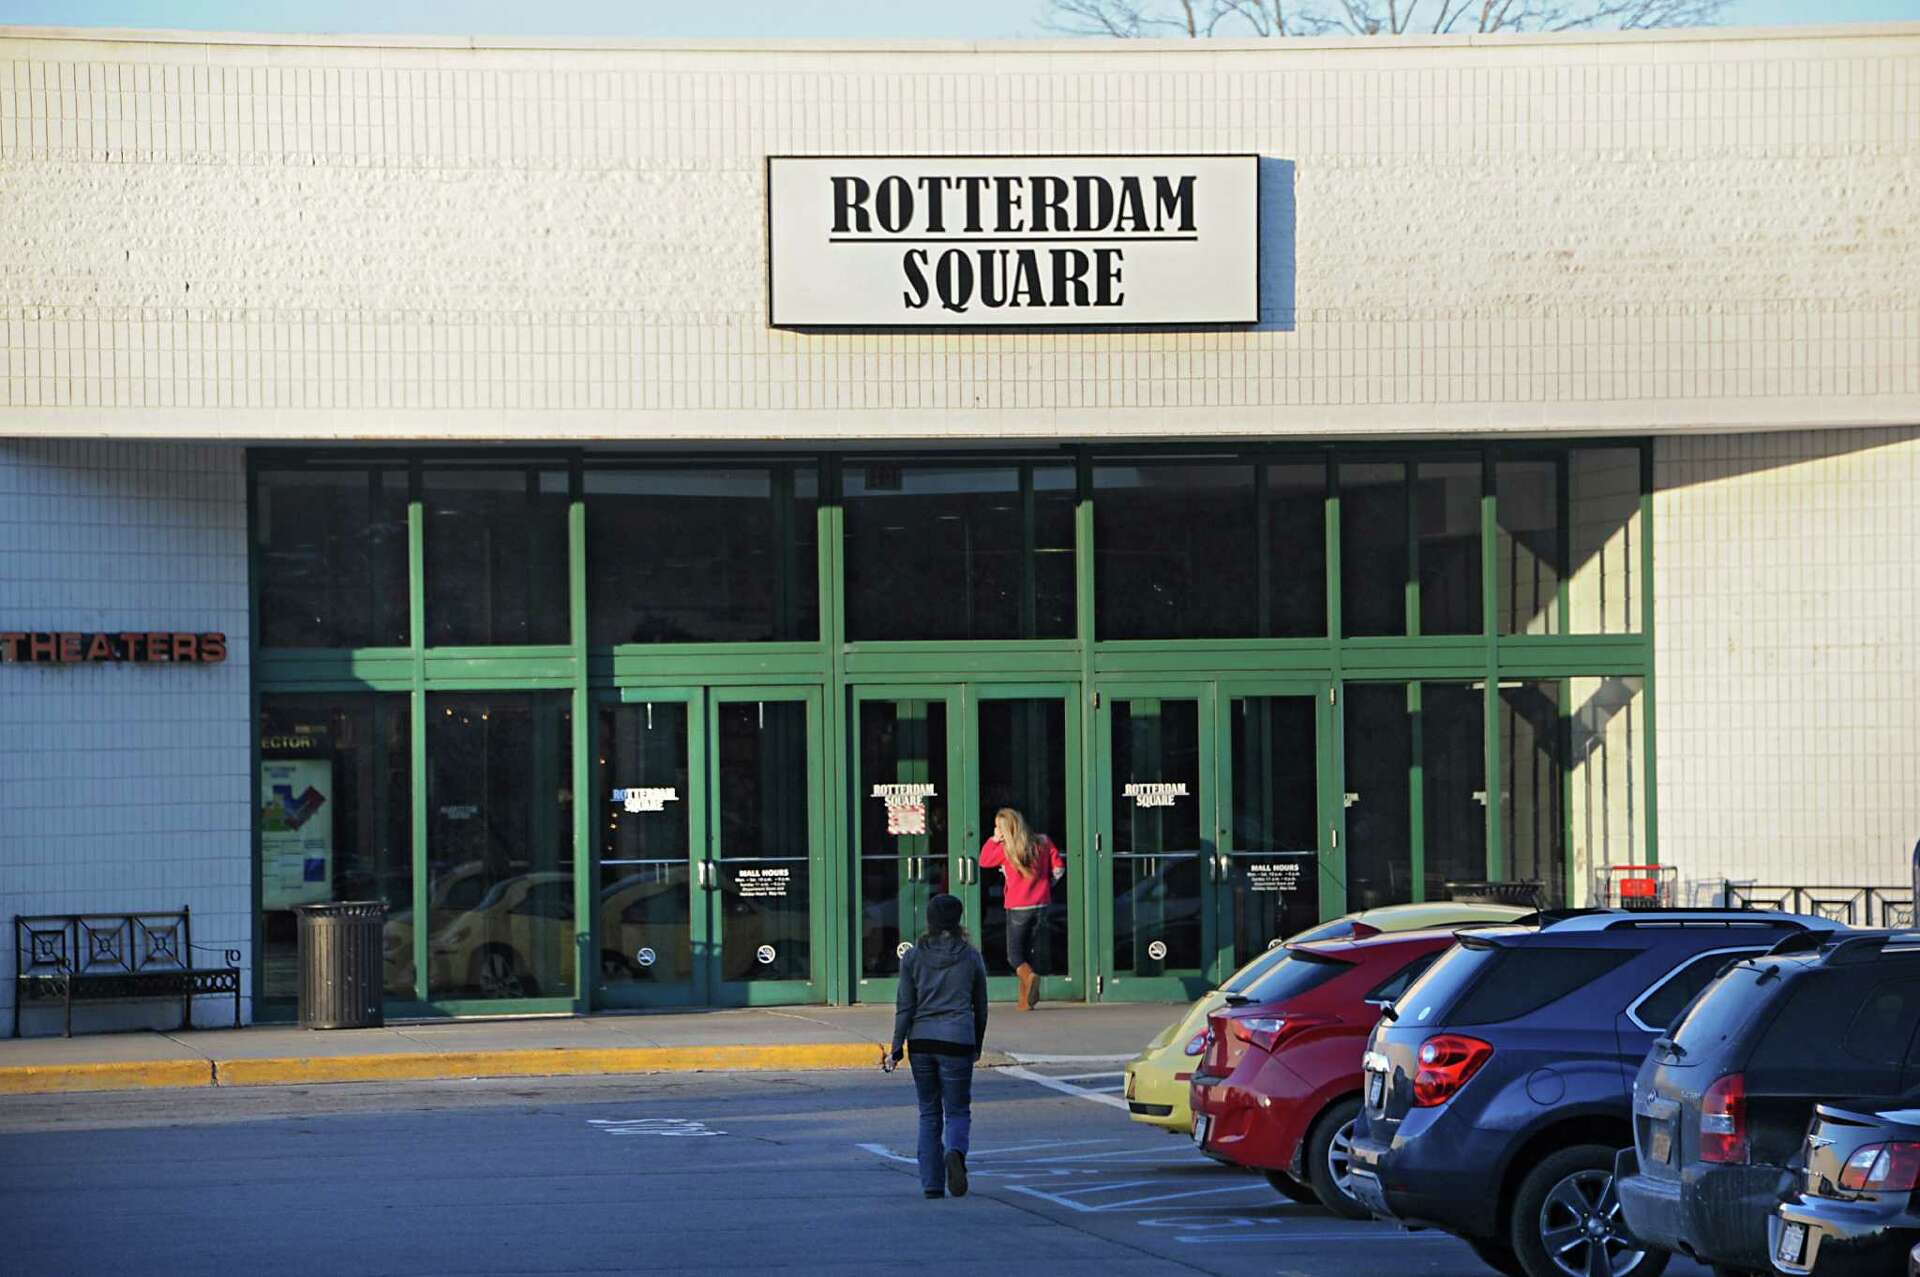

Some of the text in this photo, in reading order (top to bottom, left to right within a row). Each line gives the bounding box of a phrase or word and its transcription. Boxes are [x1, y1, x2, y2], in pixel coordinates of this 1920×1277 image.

[830, 175, 1198, 233] ROTTERDAM
[902, 248, 1125, 313] SQUARE
[0, 632, 227, 662] THEATERS
[873, 783, 935, 796] ROTTERDAM
[1125, 783, 1186, 795] ROTTERDAM
[1137, 794, 1175, 808] SQUARE
